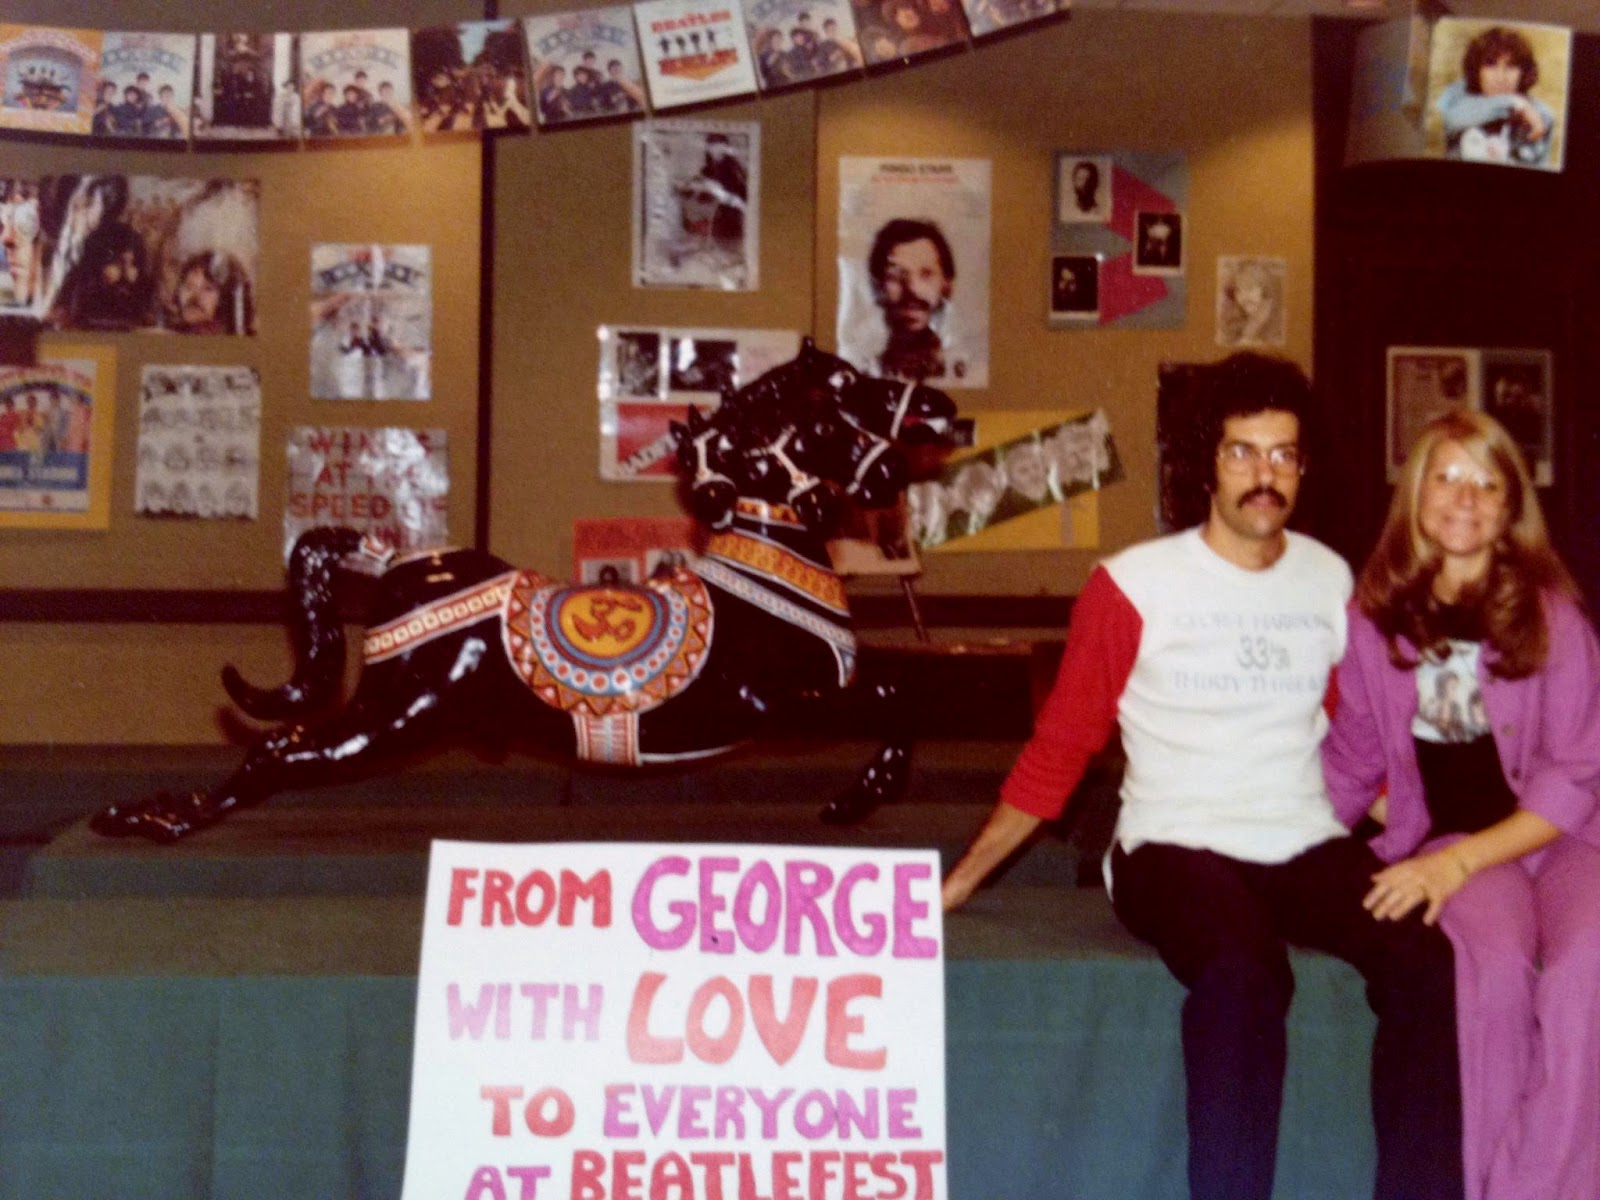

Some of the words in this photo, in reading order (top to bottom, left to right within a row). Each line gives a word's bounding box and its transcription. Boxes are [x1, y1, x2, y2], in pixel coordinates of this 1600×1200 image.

[289, 493, 392, 520] SPEED
[446, 868, 612, 928] FROM
[631, 856, 938, 960] GEORGE
[446, 983, 604, 1041] WITH
[626, 972, 888, 1071] LOVE
[480, 1084, 576, 1137] TO
[603, 1083, 923, 1140] EVERYONE
[463, 1165, 552, 1200] AT
[570, 1149, 944, 1200] BEATLEFEST
